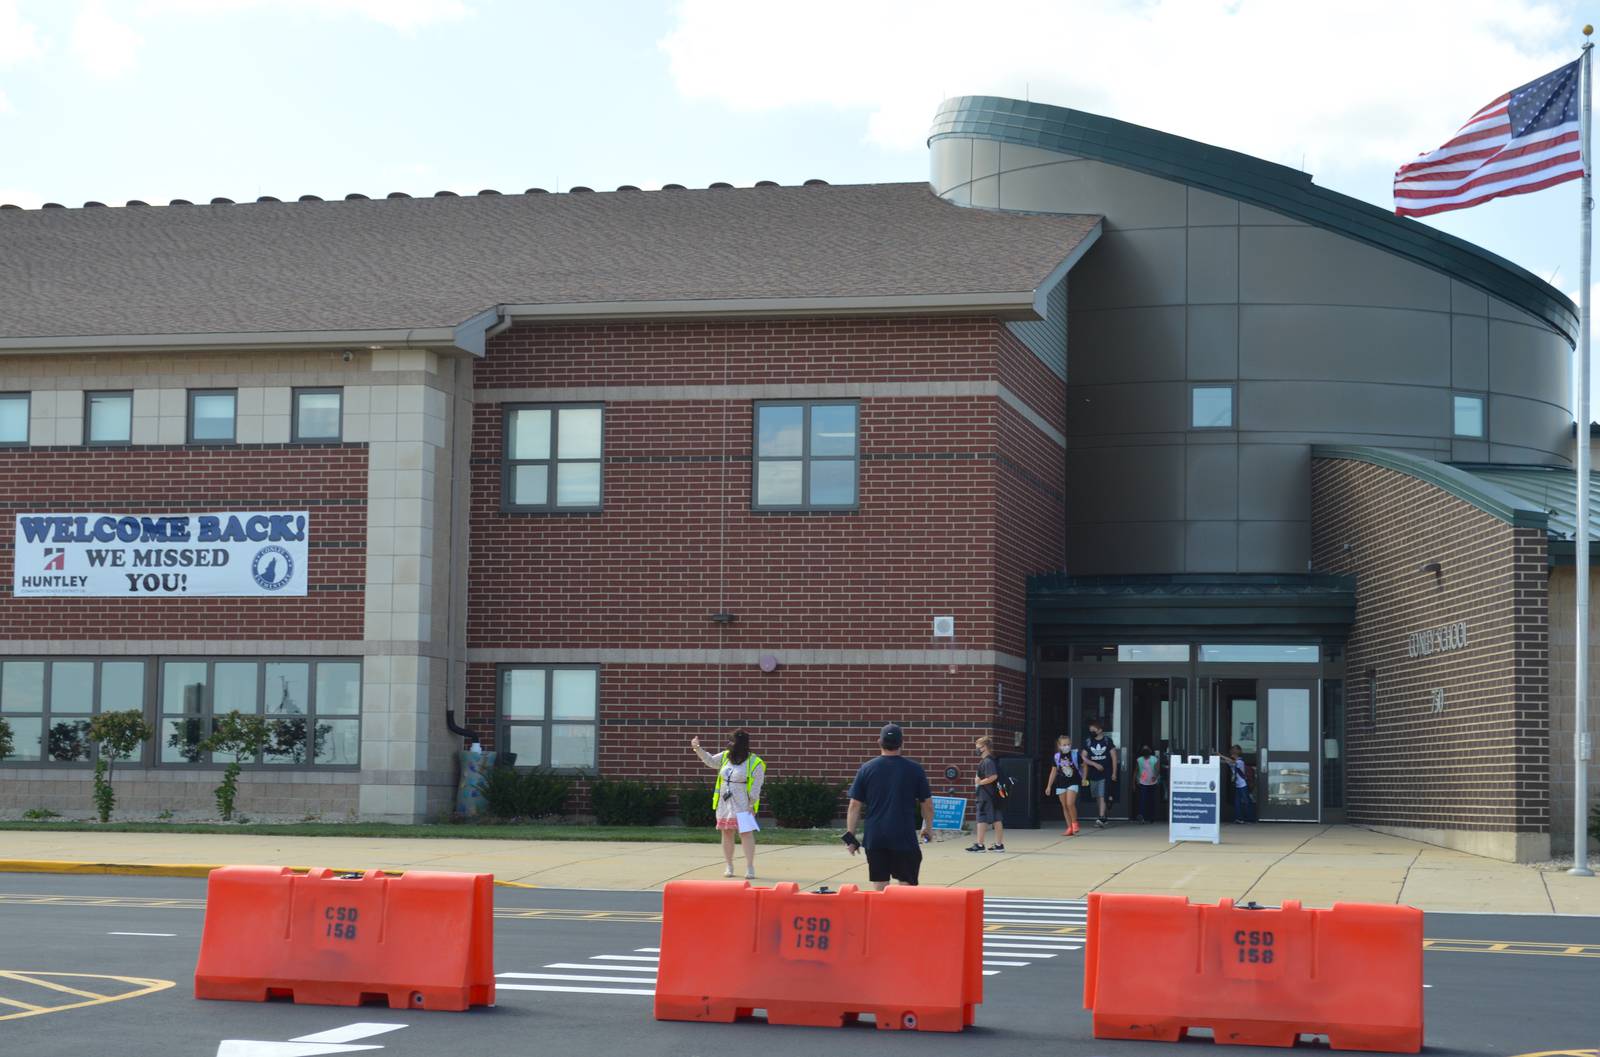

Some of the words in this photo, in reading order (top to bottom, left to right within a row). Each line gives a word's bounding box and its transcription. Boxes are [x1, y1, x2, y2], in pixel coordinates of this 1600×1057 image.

[20, 516, 191, 543] WELCOME
[198, 515, 306, 542] BACK!
[86, 549, 126, 567] WE
[132, 549, 229, 567] MISSED
[22, 576, 88, 587] HUNTLEY
[125, 573, 187, 592] YOU!
[1434, 622, 1468, 651] SCHOOL
[325, 906, 358, 921] CSD
[326, 922, 356, 940] 158
[793, 916, 831, 932] CSD
[796, 934, 829, 951] 158
[1234, 930, 1274, 946] CSD
[1239, 949, 1274, 964] 158
